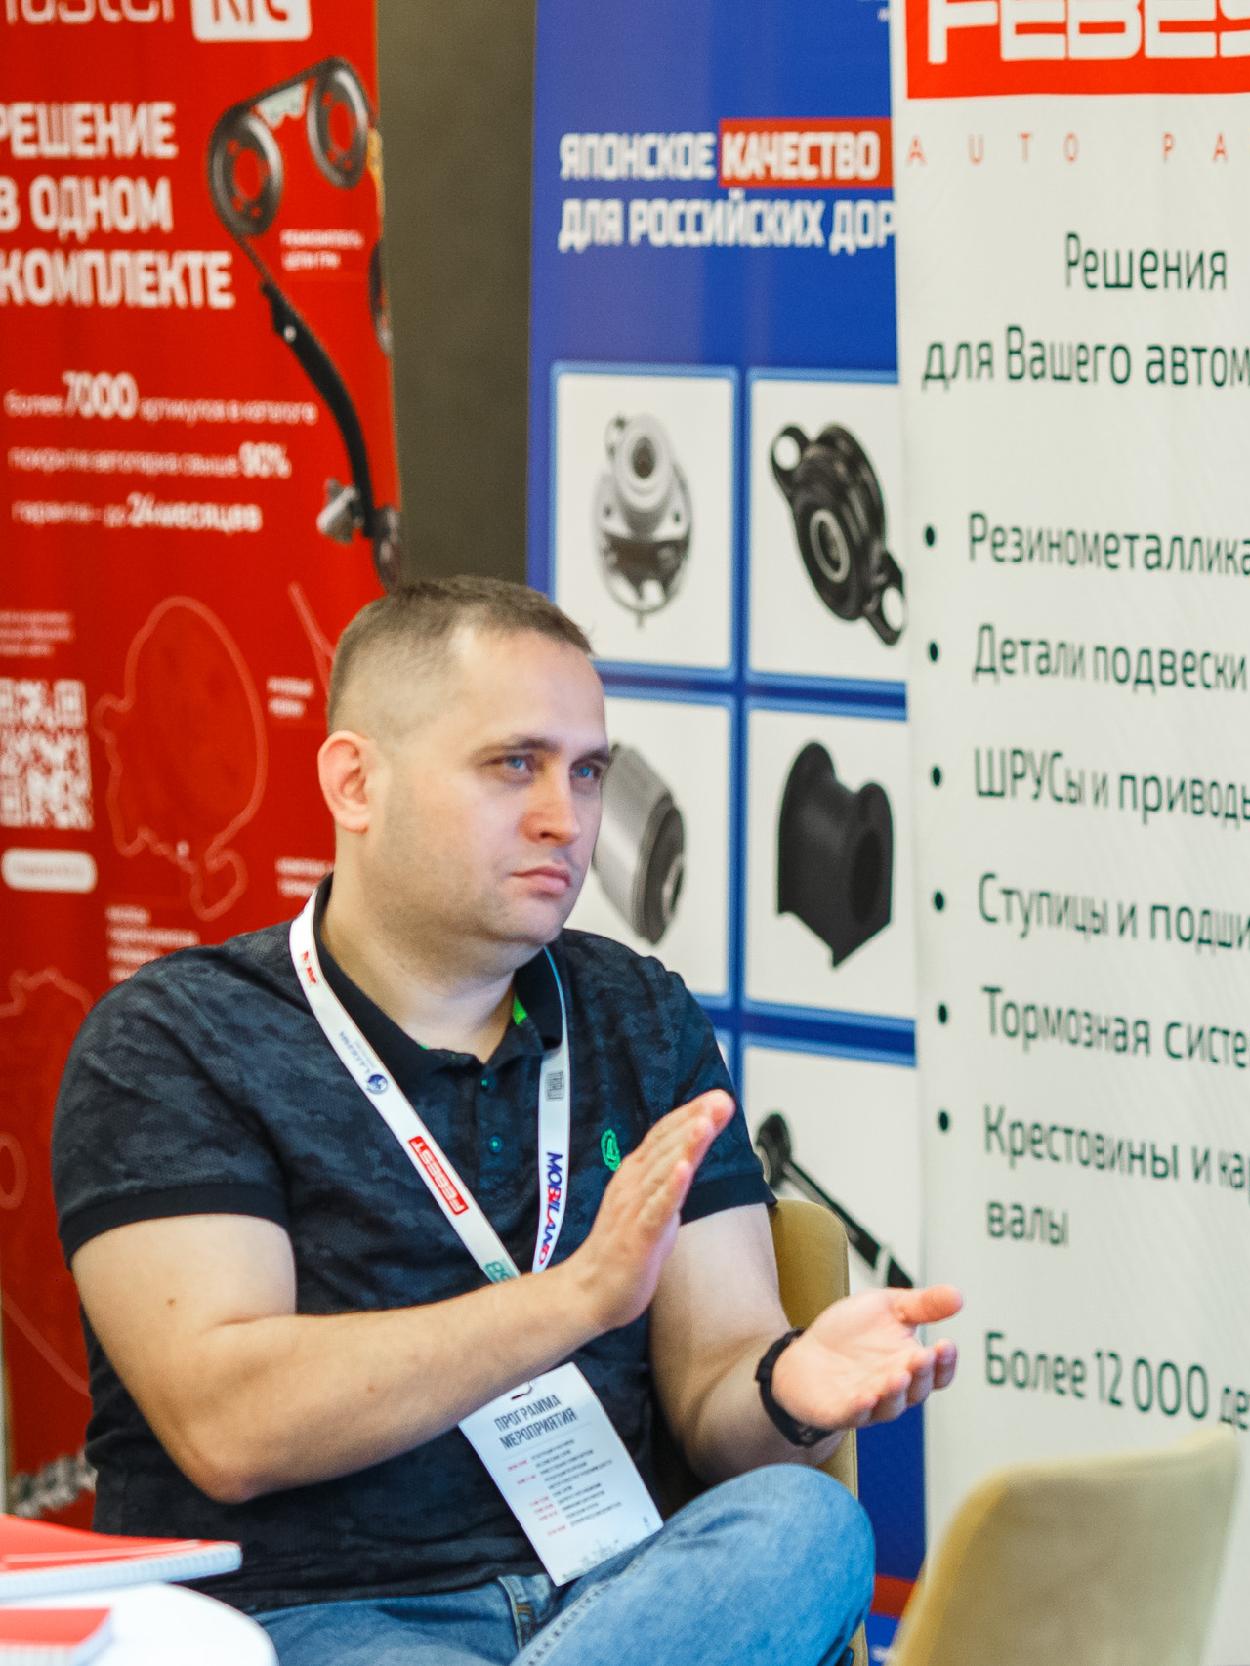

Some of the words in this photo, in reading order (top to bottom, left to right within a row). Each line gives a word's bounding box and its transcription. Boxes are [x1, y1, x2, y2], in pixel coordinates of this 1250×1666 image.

[560, 131, 716, 181] ЯПОНСКОЕ
[721, 130, 880, 181] КАЧЕСТВО
[905, 132, 1081, 166] AUTO
[30, 175, 174, 243] ОДНОМ
[558, 198, 624, 252] ДЛЯ
[629, 187, 825, 249] РОССИЙСКИХ
[828, 199, 895, 256] ДОР
[0, 247, 236, 310] КОМПЛЕКТЕ
[1065, 231, 1227, 290] Решения
[922, 341, 995, 392] для
[1006, 325, 1132, 385] Вашего
[63, 370, 139, 420] 7000
[973, 623, 1085, 685] Детали
[1093, 646, 1247, 694] подвески
[974, 747, 1084, 805] ШРУСы
[1092, 768, 1109, 811] и
[978, 872, 1108, 939] Ступицы
[1118, 903, 1137, 939] и
[981, 985, 1151, 1055] Тормозная
[983, 1104, 1180, 1180] Крестовины
[1191, 1147, 1211, 1184] и
[987, 1200, 1069, 1248] валы
[984, 1331, 1087, 1399] Более
[493, 1394, 563, 1432] ПРОГРАММА
[499, 1406, 578, 1450] МЕРОПРИЯТИЯ
